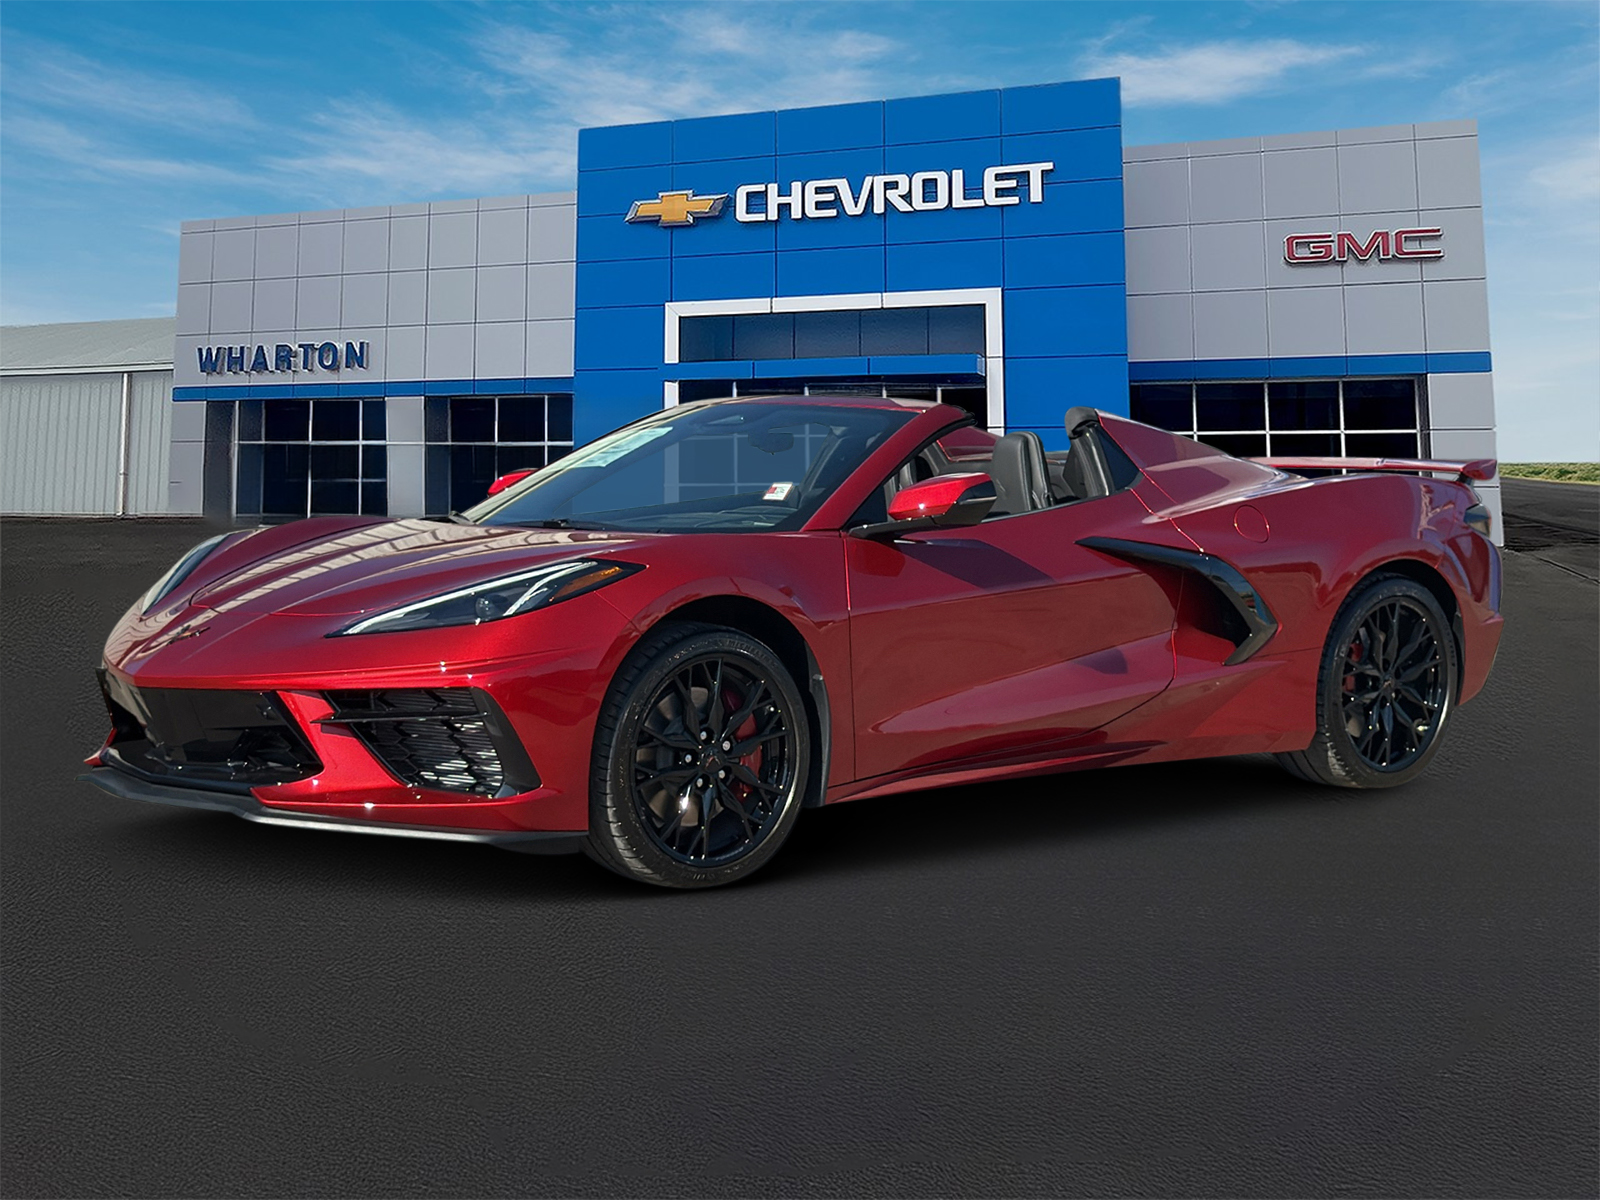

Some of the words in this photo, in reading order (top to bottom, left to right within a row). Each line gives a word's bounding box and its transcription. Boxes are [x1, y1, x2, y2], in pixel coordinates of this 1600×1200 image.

[734, 161, 1055, 223] CHEVROLET
[1283, 226, 1444, 263] GMC
[196, 339, 369, 374] WHARTON
